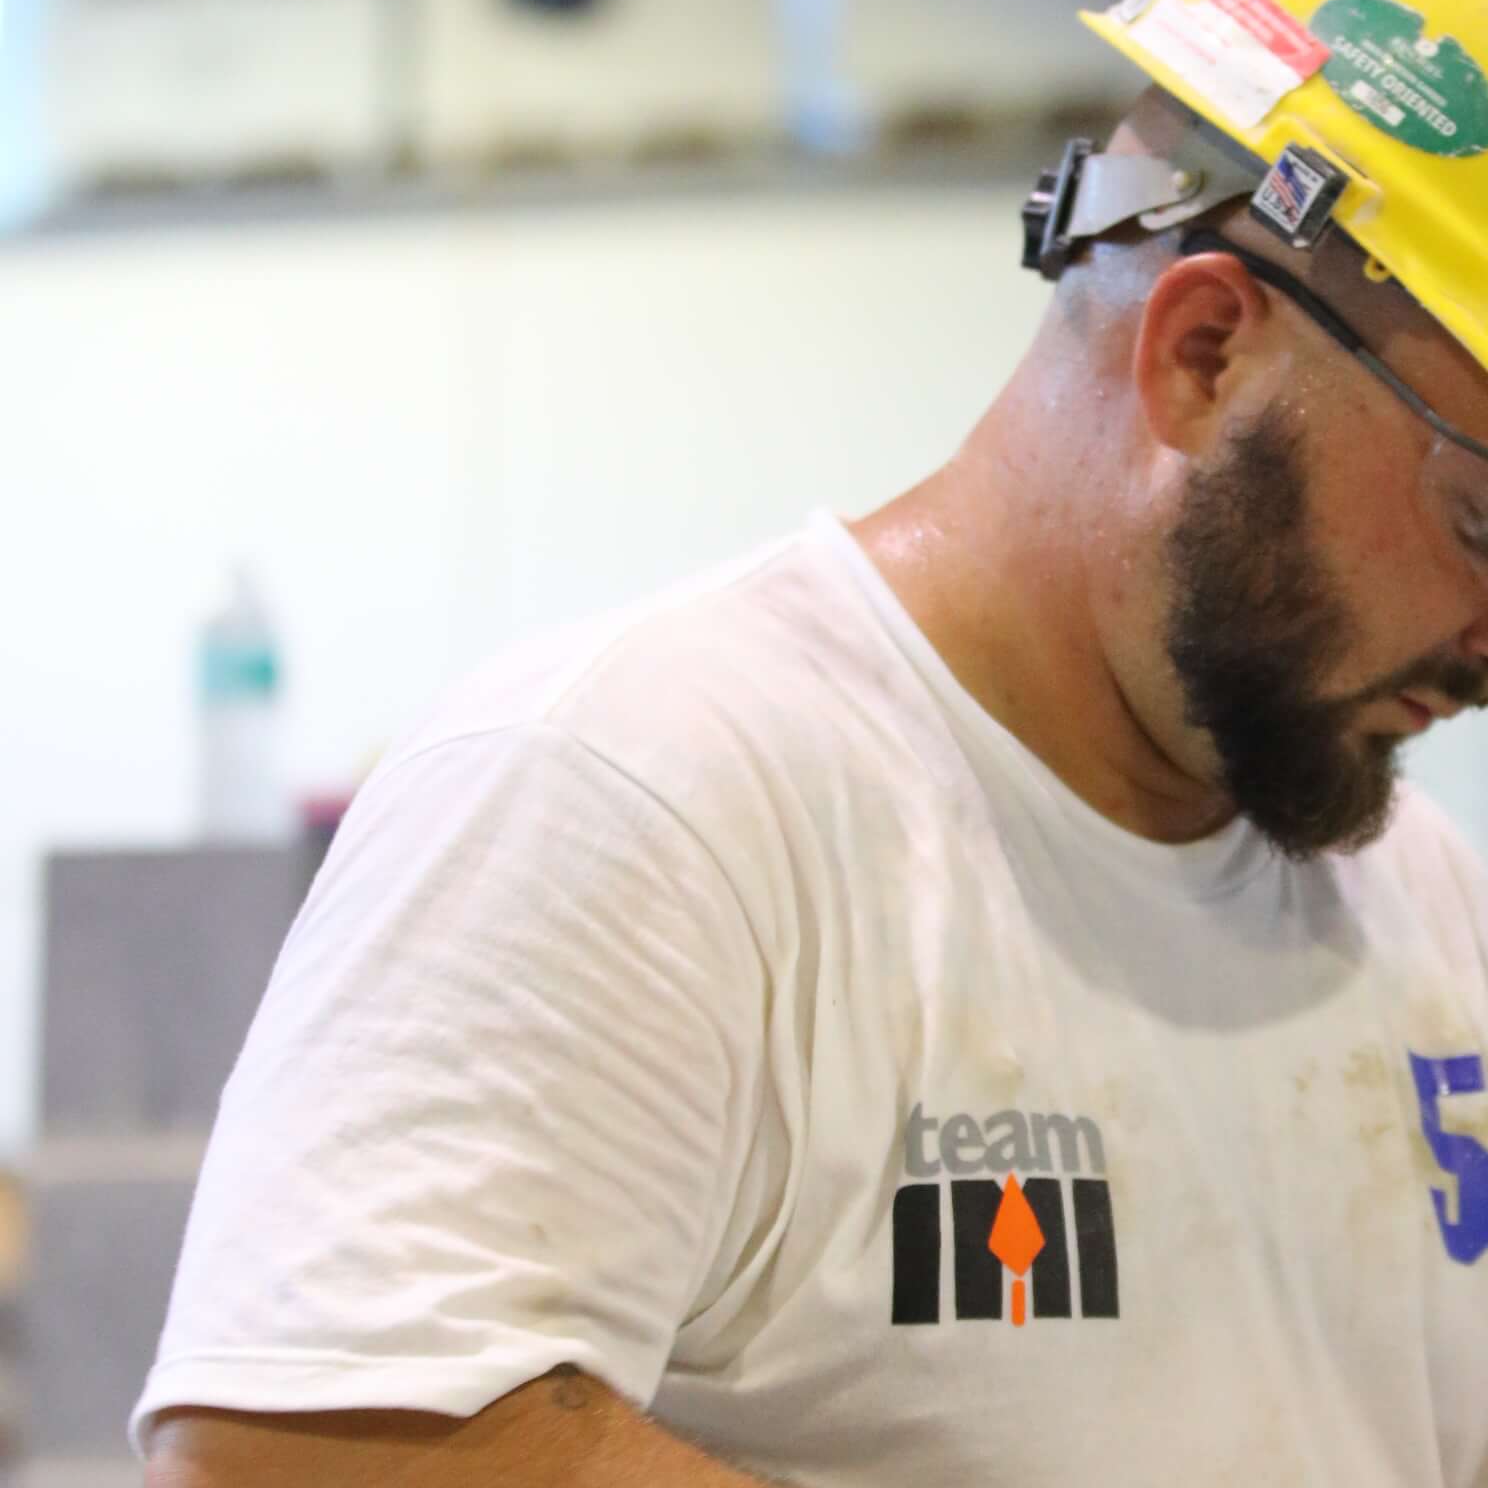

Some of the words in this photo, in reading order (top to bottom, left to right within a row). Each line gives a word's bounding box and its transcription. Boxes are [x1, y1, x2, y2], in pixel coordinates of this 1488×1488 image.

[1333, 33, 1385, 79] SAFETY
[1381, 73, 1457, 136] ORIENTED
[903, 1100, 1108, 1178] team
